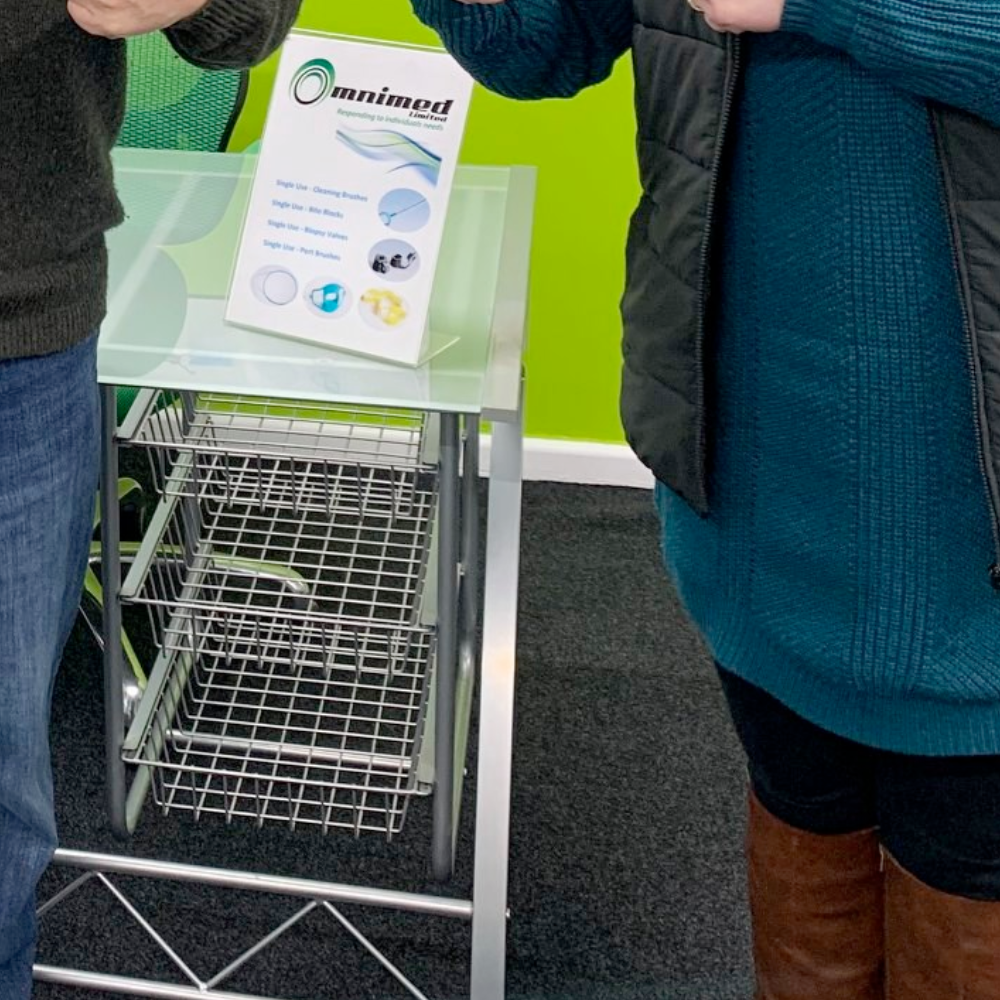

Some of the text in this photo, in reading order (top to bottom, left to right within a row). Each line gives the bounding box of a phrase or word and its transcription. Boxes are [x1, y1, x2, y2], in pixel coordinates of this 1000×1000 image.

[289, 58, 454, 115] Omnimed
[337, 108, 376, 122] Responding
[423, 121, 444, 131] needs
[408, 113, 448, 123] Limited
[276, 180, 295, 189] Single
[296, 183, 308, 191] Use
[313, 186, 340, 198] Cleaning
[342, 191, 368, 202] Brushes
[272, 199, 291, 209] Single
[292, 203, 304, 211] Use
[323, 208, 344, 219] Blocks
[268, 219, 286, 229] Single
[287, 223, 299, 231] Use
[327, 231, 348, 241] Valves
[263, 239, 281, 249] Single
[283, 243, 295, 251] Use
[300, 246, 314, 256] Port
[315, 250, 341, 261] Brushes
